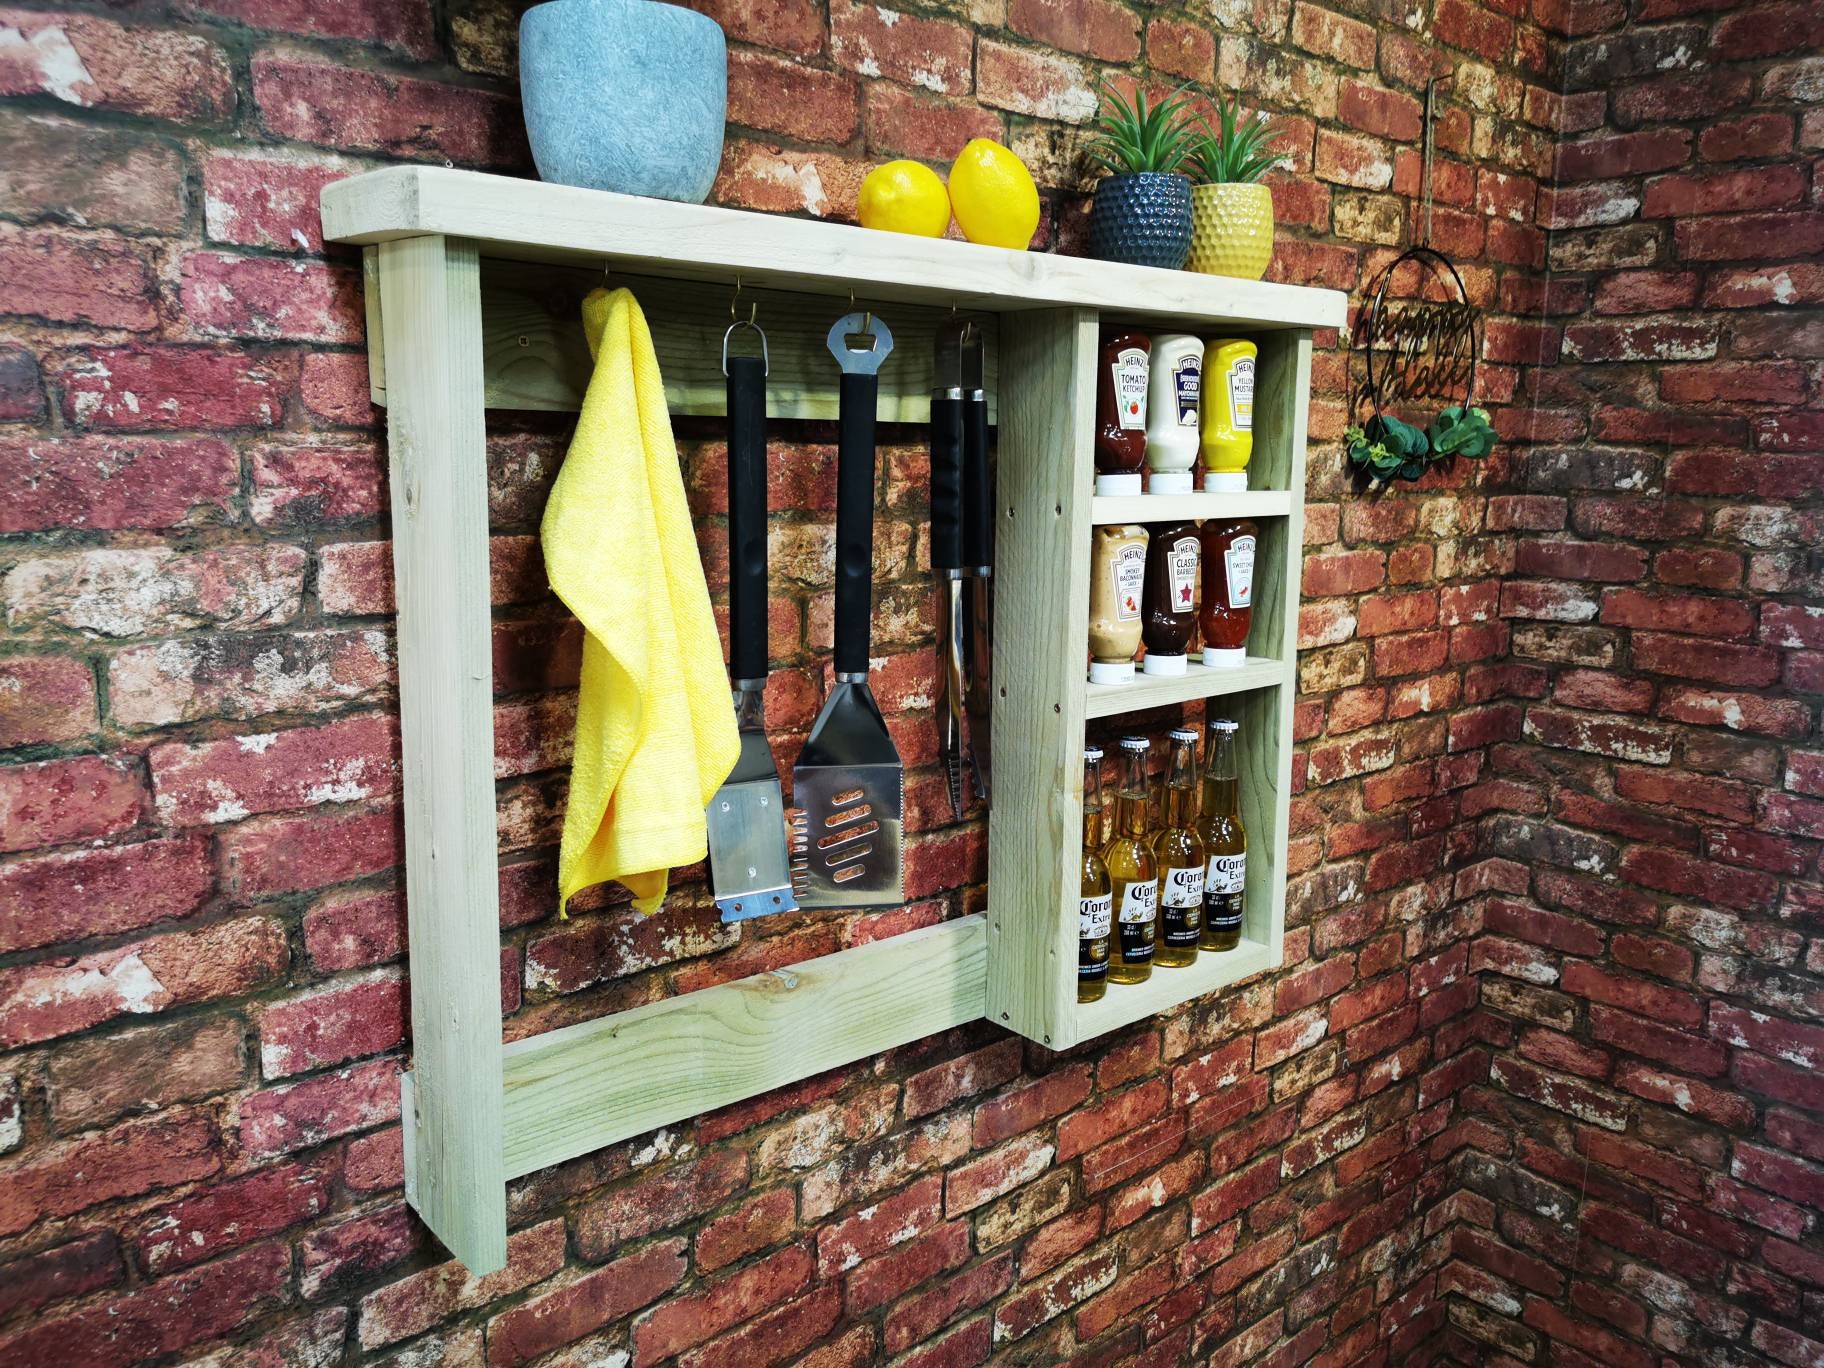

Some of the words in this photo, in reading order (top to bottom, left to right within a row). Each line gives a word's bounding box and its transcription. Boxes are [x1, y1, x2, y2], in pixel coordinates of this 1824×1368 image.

[1125, 356, 1144, 368] HEINZ
[1182, 358, 1200, 369] HEINZ
[1121, 374, 1146, 384] TOMATO
[1122, 384, 1145, 393] KETCHUP
[1184, 382, 1198, 390] GOOD
[1124, 550, 1143, 560] HEINZ
